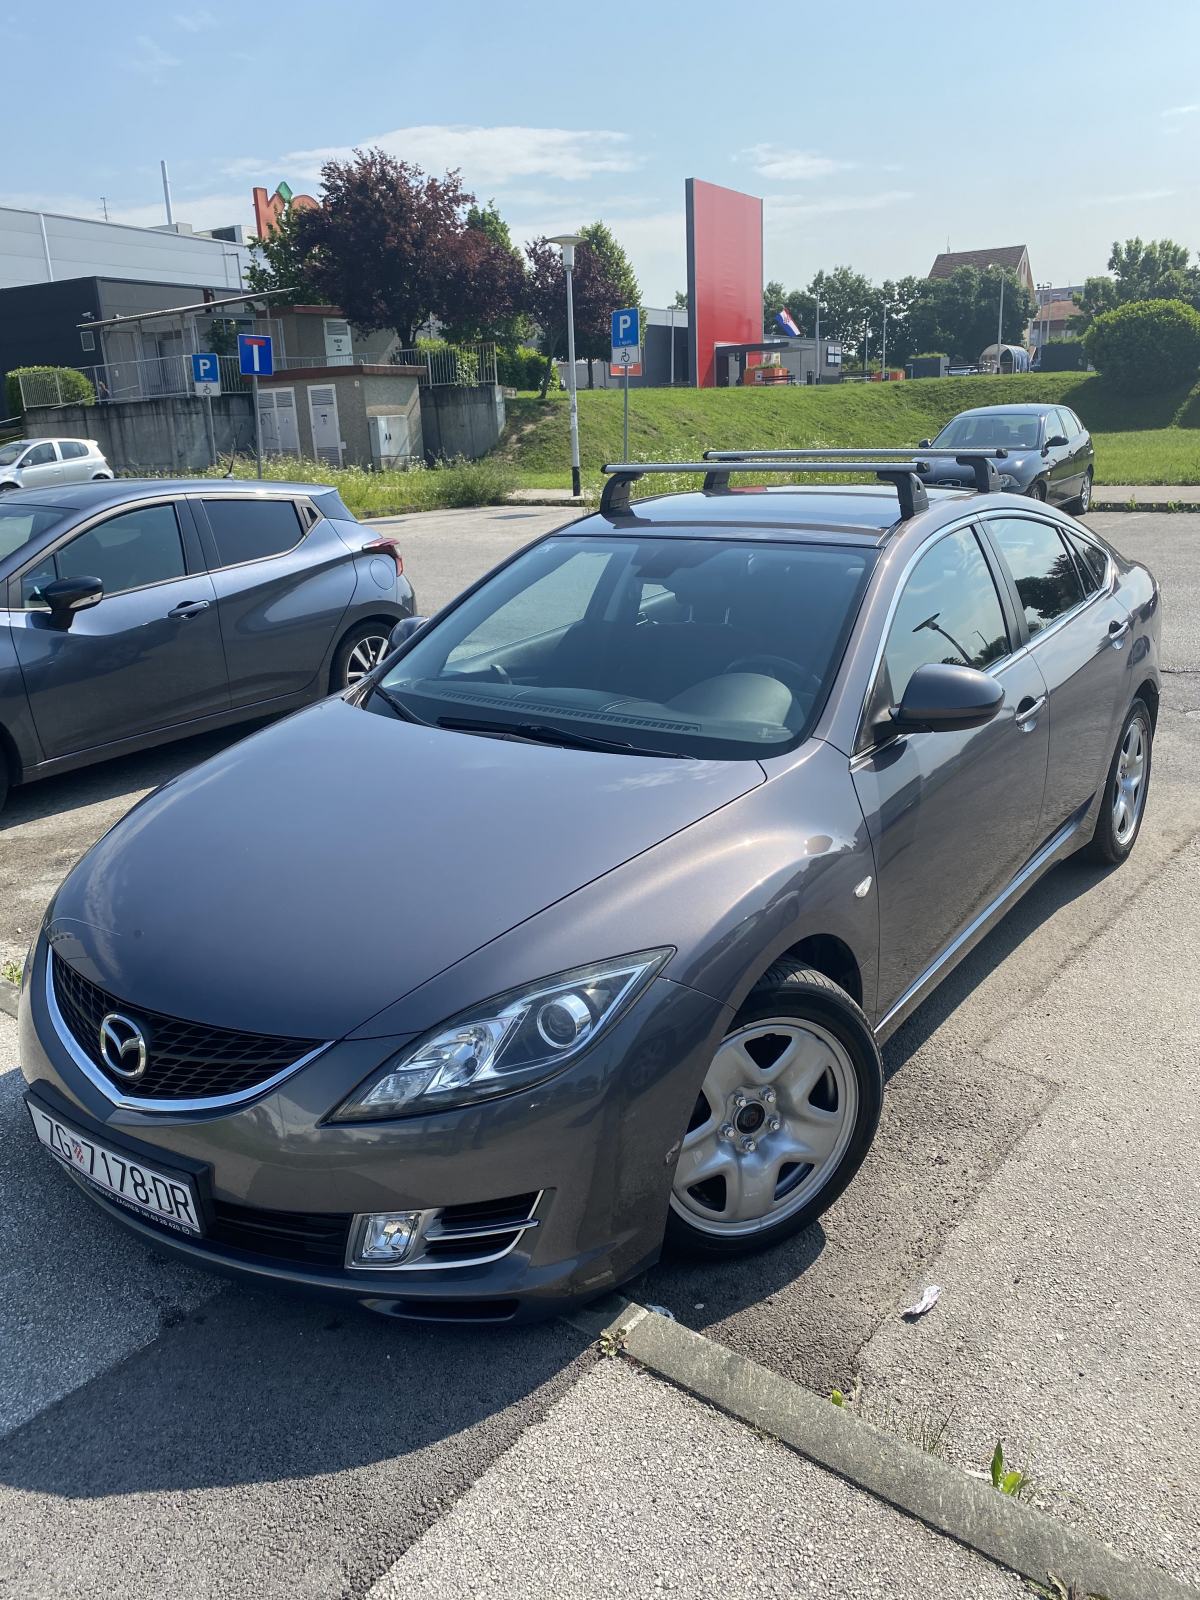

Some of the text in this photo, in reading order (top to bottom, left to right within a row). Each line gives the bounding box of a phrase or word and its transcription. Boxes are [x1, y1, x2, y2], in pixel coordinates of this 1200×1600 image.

[619, 315, 631, 338] P
[199, 359, 210, 377] P
[41, 1114, 73, 1160] ZG
